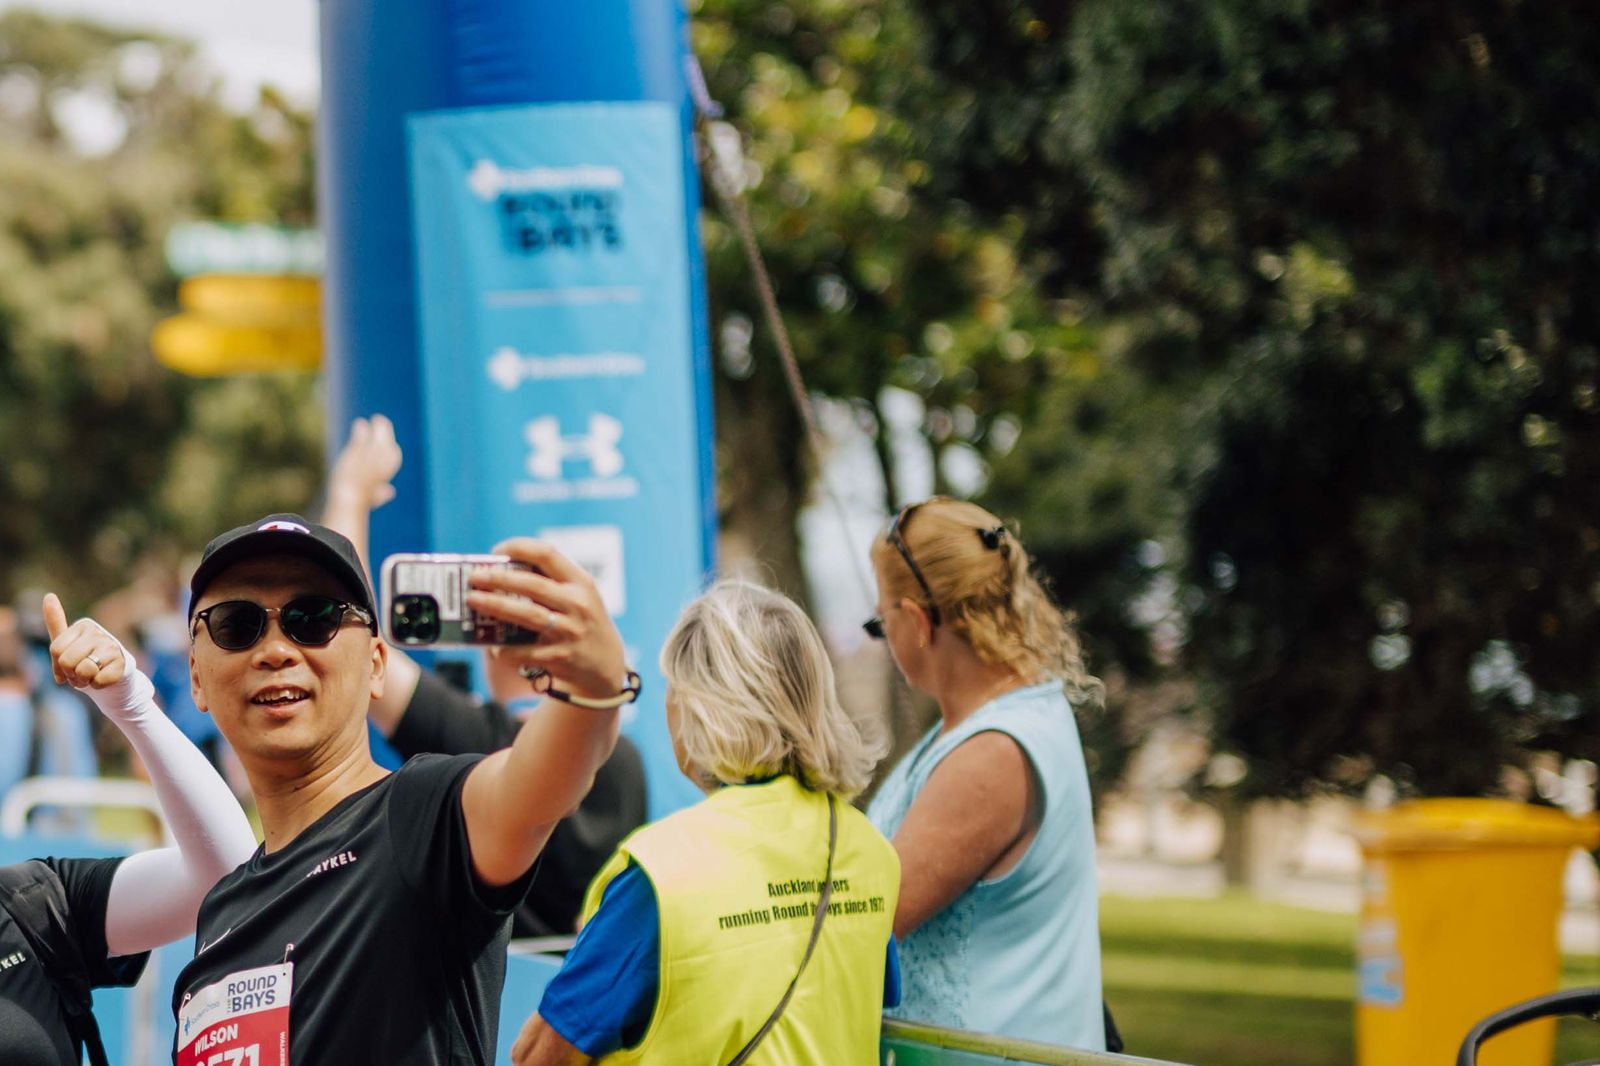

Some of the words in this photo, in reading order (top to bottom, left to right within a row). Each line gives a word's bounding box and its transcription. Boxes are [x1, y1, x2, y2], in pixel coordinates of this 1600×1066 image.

[306, 851, 357, 877] AYKEL
[719, 908, 771, 930] running
[772, 902, 809, 921] Round
[826, 903, 842, 916] ays
[844, 900, 868, 914] since
[228, 975, 277, 996] ROUND
[232, 989, 276, 1013] BAYS
[195, 1023, 238, 1057] WILSON
